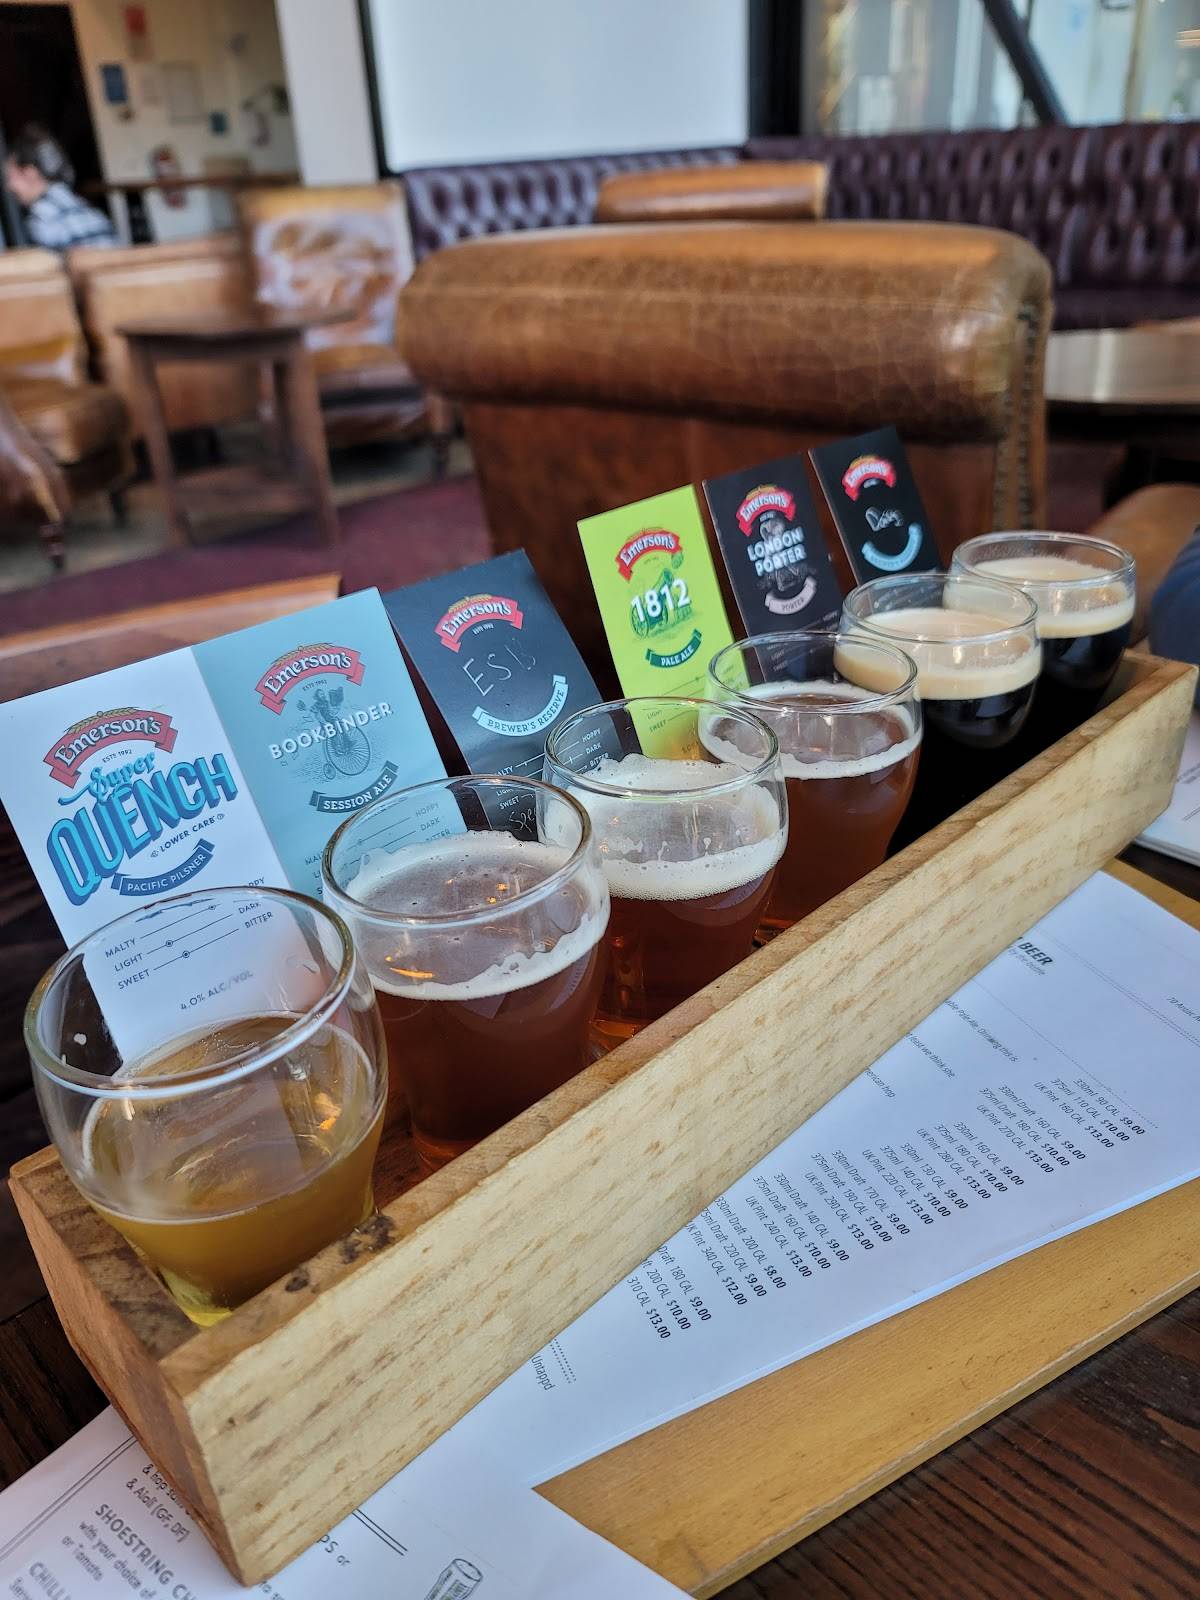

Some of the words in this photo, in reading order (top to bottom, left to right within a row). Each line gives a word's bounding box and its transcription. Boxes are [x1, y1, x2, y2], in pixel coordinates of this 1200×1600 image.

[620, 533, 675, 566] Emerson's
[747, 526, 804, 561] LONDON
[755, 543, 806, 576] PORTER
[442, 601, 513, 636] Emerson's
[631, 578, 692, 622] 1812
[263, 652, 352, 695] Emerson's
[661, 653, 681, 666] PALE
[681, 645, 694, 659] ALE
[268, 702, 393, 760] BOOKBINDER
[488, 719, 537, 733] BREWER'S
[538, 689, 564, 725] RESERVE
[54, 717, 162, 768] Emerson's
[586, 742, 601, 754] DARK
[58, 752, 155, 806] Super
[323, 792, 373, 810] SESSION
[374, 774, 393, 796] ALE
[499, 795, 519, 810] SWEET
[47, 753, 238, 906] QUENCH
[160, 830, 190, 852] LOWER
[192, 815, 217, 832] CARB
[420, 817, 440, 831] DARK
[127, 878, 169, 892] PACIFIC
[170, 854, 206, 881] PILSNER
[105, 937, 137, 958] MALTY
[114, 953, 144, 972] LIGHT
[238, 902, 262, 915] DARK
[117, 969, 151, 990] SWEET
[244, 911, 274, 929] BITTER
[1018, 942, 1053, 966] BEER
[180, 993, 205, 1010] 4.0%
[1034, 1081, 1045, 1092] UK
[1044, 1089, 1060, 1103] Pint
[1058, 1102, 1073, 1114] 160
[1070, 1112, 1086, 1126] CAL
[1084, 1125, 1114, 1148] $13.00
[1051, 1078, 1074, 1096] 375ml
[1074, 1096, 1090, 1109] 110
[1085, 1106, 1101, 1119] CAL
[1101, 1119, 1130, 1141] $10.00
[1073, 1078, 1098, 1097] 330ml
[1095, 1096, 1105, 1106] 90
[1105, 1102, 1121, 1117] CAL
[1120, 1116, 1145, 1135] $9.00
[917, 1128, 930, 1139] UK
[926, 1136, 941, 1150] Pint
[937, 1151, 953, 1164] 280
[949, 1162, 966, 1175] CAL
[963, 1175, 992, 1199] $13.00
[934, 1124, 957, 1144] 375ml
[954, 1144, 970, 1157] 180
[966, 1155, 982, 1168] CAL
[979, 1168, 1008, 1193] $10.00
[953, 1121, 977, 1141] 330ml
[975, 1141, 990, 1154] 160
[986, 1152, 1002, 1166] CAL
[1000, 1166, 1025, 1186] $9.00
[976, 1104, 988, 1115] UK
[986, 1112, 1002, 1126] Pint
[999, 1125, 1016, 1138] 270
[1011, 1137, 1027, 1150] CAL
[1025, 1150, 1054, 1174] $13.00
[811, 1152, 833, 1175] 375ml
[829, 1172, 846, 1189] Draft
[843, 1189, 858, 1202] 190
[854, 1201, 869, 1215] CAL
[865, 1215, 892, 1243] $10.00
[832, 1150, 854, 1171] 330ml
[849, 1168, 866, 1186] Draft
[863, 1185, 879, 1199] 170
[874, 1198, 890, 1213] CAL
[886, 1213, 910, 1235] $9.00
[862, 1149, 875, 1161] UK
[871, 1158, 886, 1173] Pint
[882, 1172, 898, 1186] 220
[894, 1184, 909, 1198] CAL
[906, 1199, 934, 1225] $13.00
[880, 1145, 904, 1166] 375ml
[901, 1166, 915, 1179] 140
[911, 1177, 926, 1192] CAL
[923, 1192, 952, 1217] $10.00
[900, 1142, 924, 1163] 330ml
[920, 1163, 935, 1176] 130
[931, 1175, 947, 1189] CAL
[944, 1189, 969, 1209] $9.00
[745, 1196, 758, 1209] UK
[755, 1205, 768, 1221] Pint
[763, 1221, 780, 1236] 240
[775, 1234, 790, 1249] CAL
[786, 1250, 813, 1278] $13.00
[752, 1175, 773, 1199] 375ml
[768, 1195, 786, 1213] Draft
[784, 1213, 799, 1228] 160
[793, 1227, 808, 1241] CAL
[804, 1241, 831, 1269] $10.00
[773, 1173, 795, 1199] 330ml
[789, 1192, 808, 1210] Draft
[804, 1210, 819, 1224] 140
[815, 1223, 829, 1239] CAL
[826, 1238, 850, 1261] $9.00
[804, 1171, 818, 1185] UK
[815, 1181, 828, 1196] Pint
[824, 1196, 840, 1210] 290
[836, 1208, 850, 1223] CAL
[847, 1223, 874, 1250] $13.00
[690, 1230, 706, 1247] Pint
[701, 1246, 717, 1262] 340
[712, 1261, 727, 1276] CAL
[722, 1276, 748, 1306] $12.00
[710, 1224, 728, 1242] Draft
[724, 1243, 740, 1258] 220
[733, 1257, 749, 1272] CAL
[744, 1273, 767, 1297] $9.00
[729, 1217, 747, 1235] Draft
[742, 1236, 758, 1250] 200
[753, 1249, 768, 1265] CAL
[764, 1265, 787, 1289] $8.00
[626, 1276, 643, 1292] 310
[636, 1291, 652, 1308] CAL
[646, 1308, 671, 1339] $13.00
[646, 1269, 663, 1284] 200
[656, 1283, 672, 1300] CAL
[666, 1300, 692, 1330] $10.00
[670, 1266, 686, 1280] 180
[680, 1280, 695, 1296] CAL
[689, 1296, 712, 1322] $9.00
[531, 1356, 556, 1391] Untappd
[92, 1537, 117, 1561] your
[113, 1558, 142, 1590] choice
[95, 1503, 174, 1585] SHOESTRING
